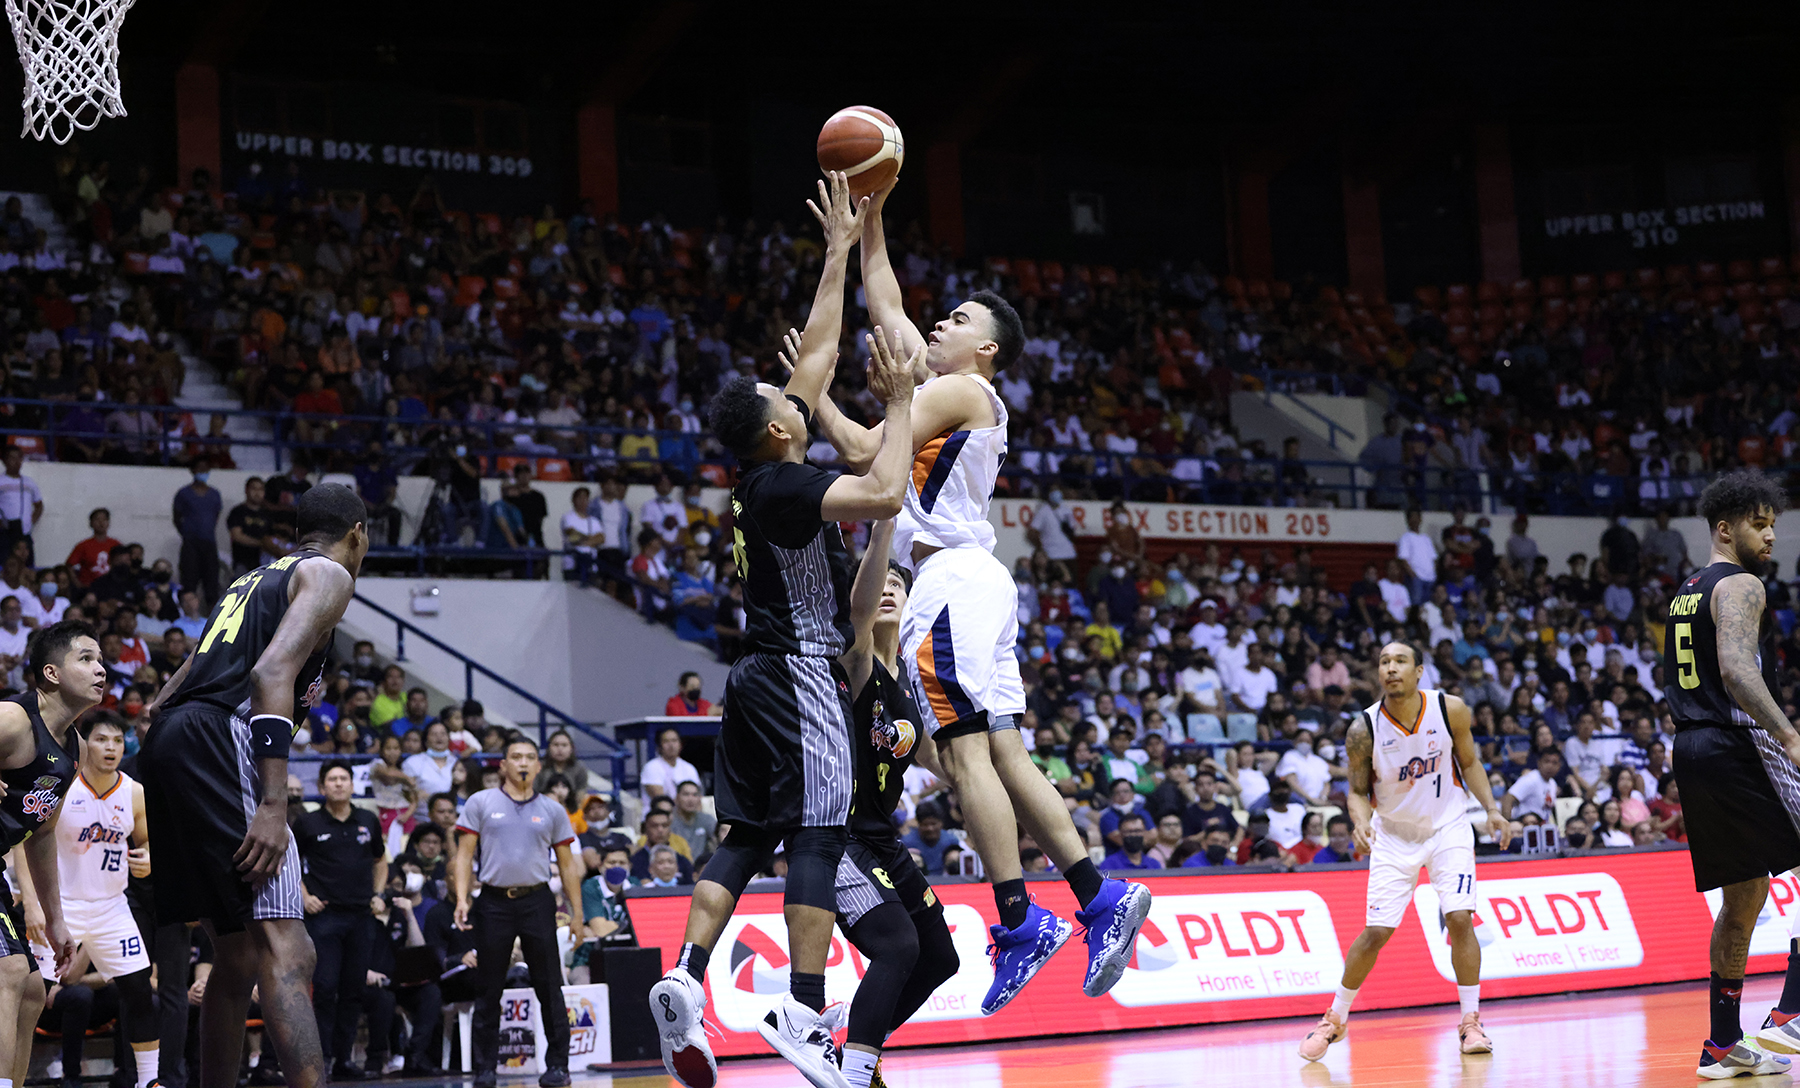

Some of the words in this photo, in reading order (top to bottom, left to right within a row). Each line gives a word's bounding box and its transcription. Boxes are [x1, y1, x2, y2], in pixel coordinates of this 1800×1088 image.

[236, 132, 313, 157] UPPER
[322, 139, 374, 164] BOX
[382, 144, 481, 173] SECTION
[488, 154, 533, 178] 309
[1545, 213, 1615, 238] UPPER
[1622, 208, 1666, 231] BOX
[1675, 201, 1765, 226] SECTION
[1632, 226, 1679, 248] 310
[1001, 504, 1086, 530] LOR
[1103, 507, 1151, 531] BX
[1167, 510, 1269, 535] SECTION
[1285, 512, 1332, 536] 205
[1674, 622, 1701, 690] 5
[1457, 874, 1472, 895] 11
[1487, 890, 1610, 938] PLDT
[119, 936, 141, 958] 19
[1175, 909, 1311, 960] PLDT
[1512, 951, 1564, 968] Home
[1578, 945, 1621, 964] Fiber
[1197, 974, 1255, 992] Home
[1273, 969, 1321, 988] Fiber
[926, 993, 967, 1012] iber
[568, 1029, 597, 1056] SH
